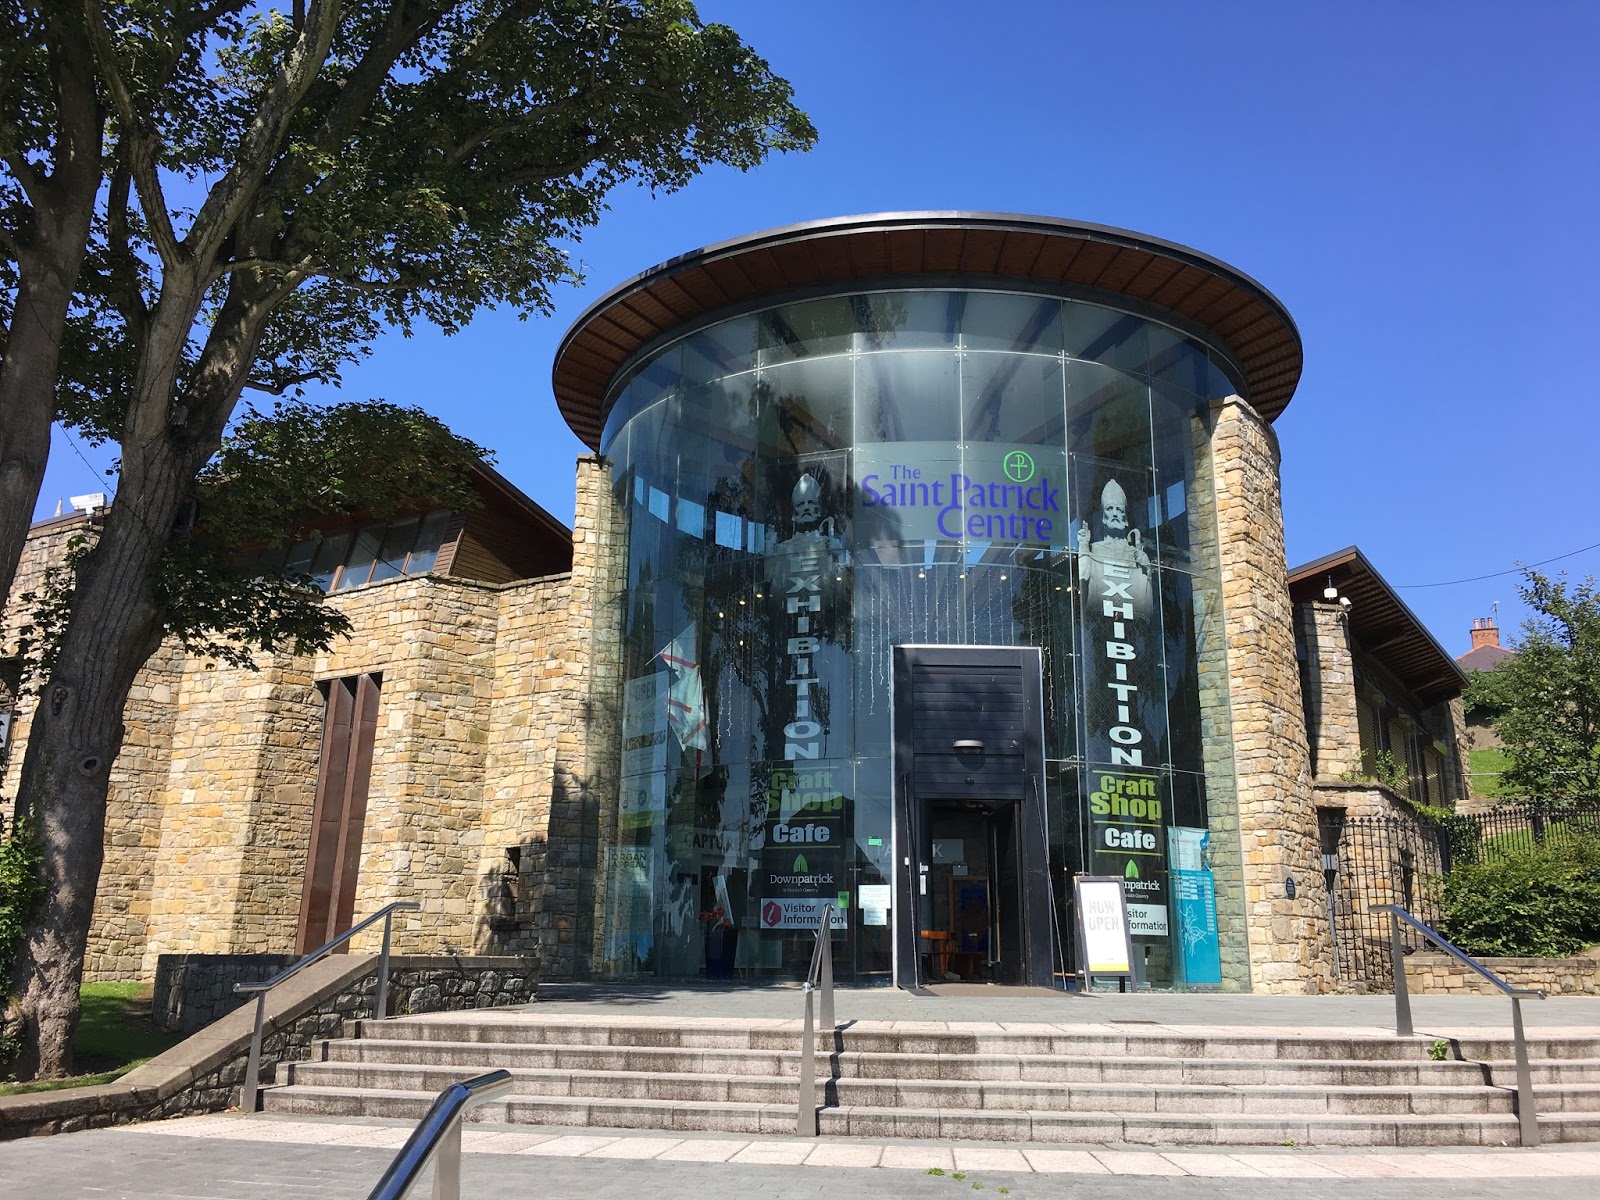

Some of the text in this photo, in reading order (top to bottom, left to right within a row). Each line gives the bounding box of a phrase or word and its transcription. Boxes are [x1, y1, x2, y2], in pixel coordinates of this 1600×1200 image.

[890, 464, 921, 480] The
[861, 473, 1061, 513] Saint Patrick
[937, 505, 1054, 541] Centre
[783, 556, 823, 760] EXHIBITION
[1101, 560, 1143, 767] EXHIBITION
[770, 771, 833, 789] Craft
[1100, 775, 1157, 797] Craft
[766, 789, 843, 812] Shop
[1090, 791, 1163, 820] Shop
[772, 823, 830, 843] Cafe
[1104, 827, 1157, 850] Cafe
[611, 852, 647, 861] ORGAN
[611, 860, 647, 868] APPEAL
[769, 872, 834, 886] Downpatrick
[1123, 879, 1160, 892] npatrick
[783, 903, 816, 913] Visitor
[1088, 899, 1115, 914] NOW
[1127, 908, 1148, 919] sitor
[783, 914, 844, 924] Informaon
[1088, 916, 1120, 931] OPEN
[1127, 920, 1167, 931] formation
